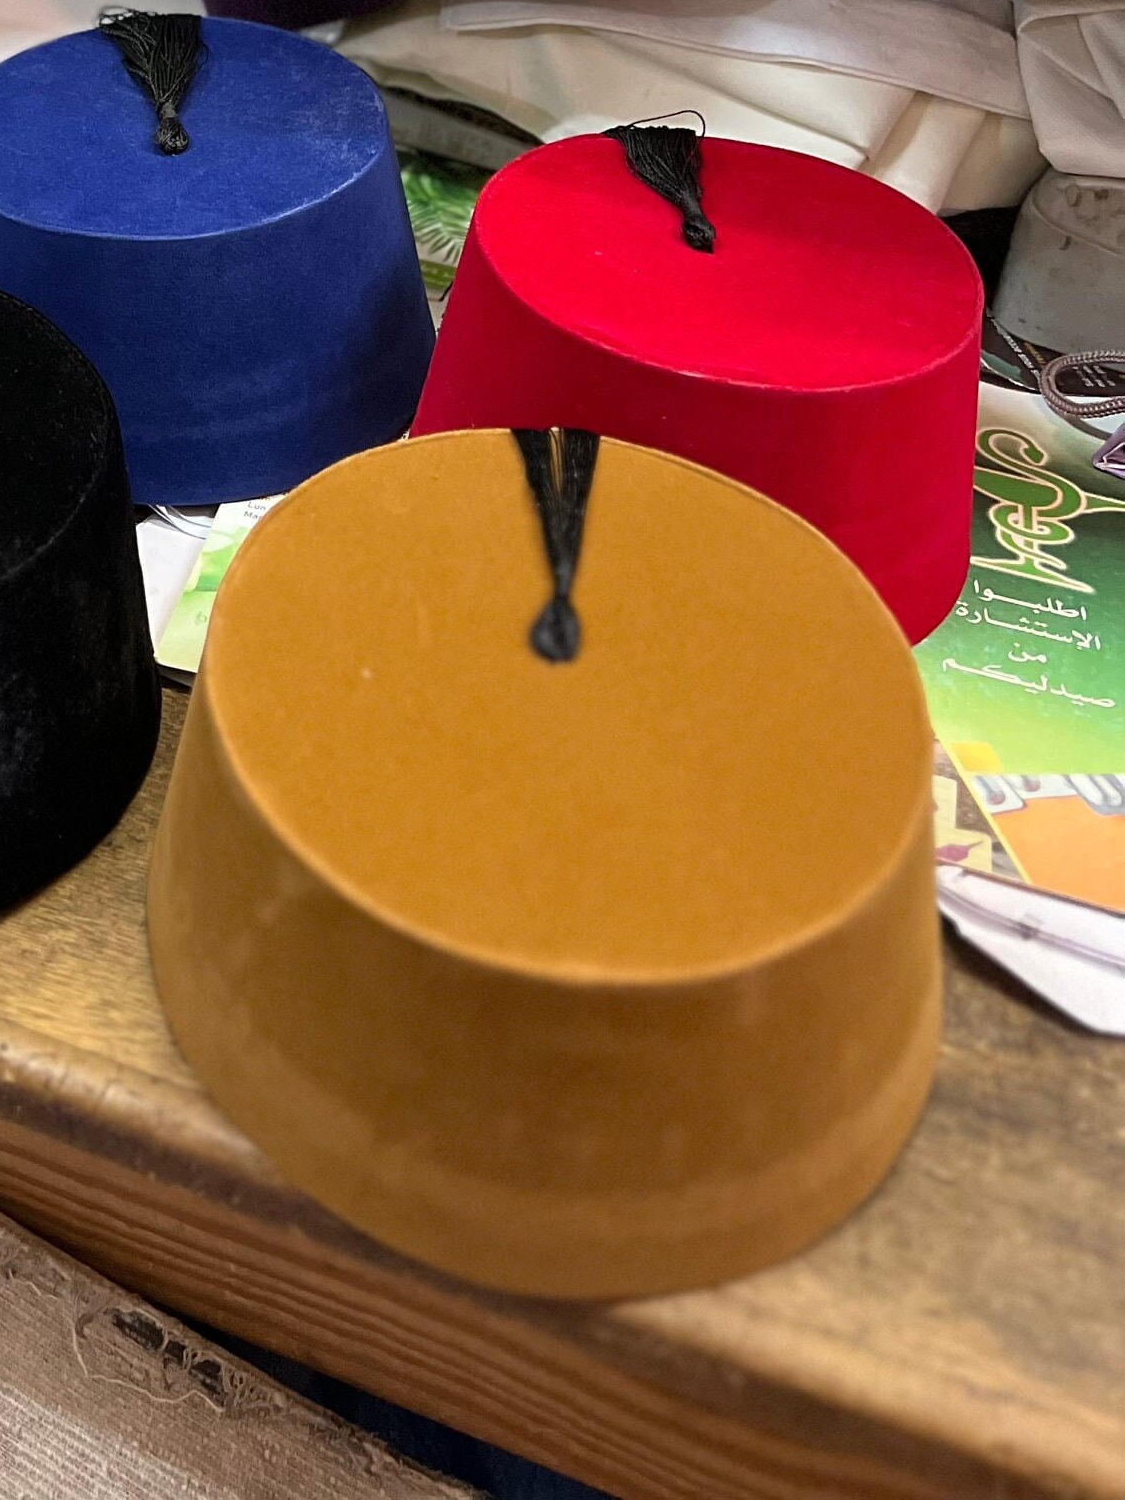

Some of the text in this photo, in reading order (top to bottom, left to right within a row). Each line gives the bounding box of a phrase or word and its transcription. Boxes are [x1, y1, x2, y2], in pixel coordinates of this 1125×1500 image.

[973, 579, 1087, 621] اطلبوا
[1007, 642, 1048, 663] من
[942, 658, 1116, 708] صيدليكم
